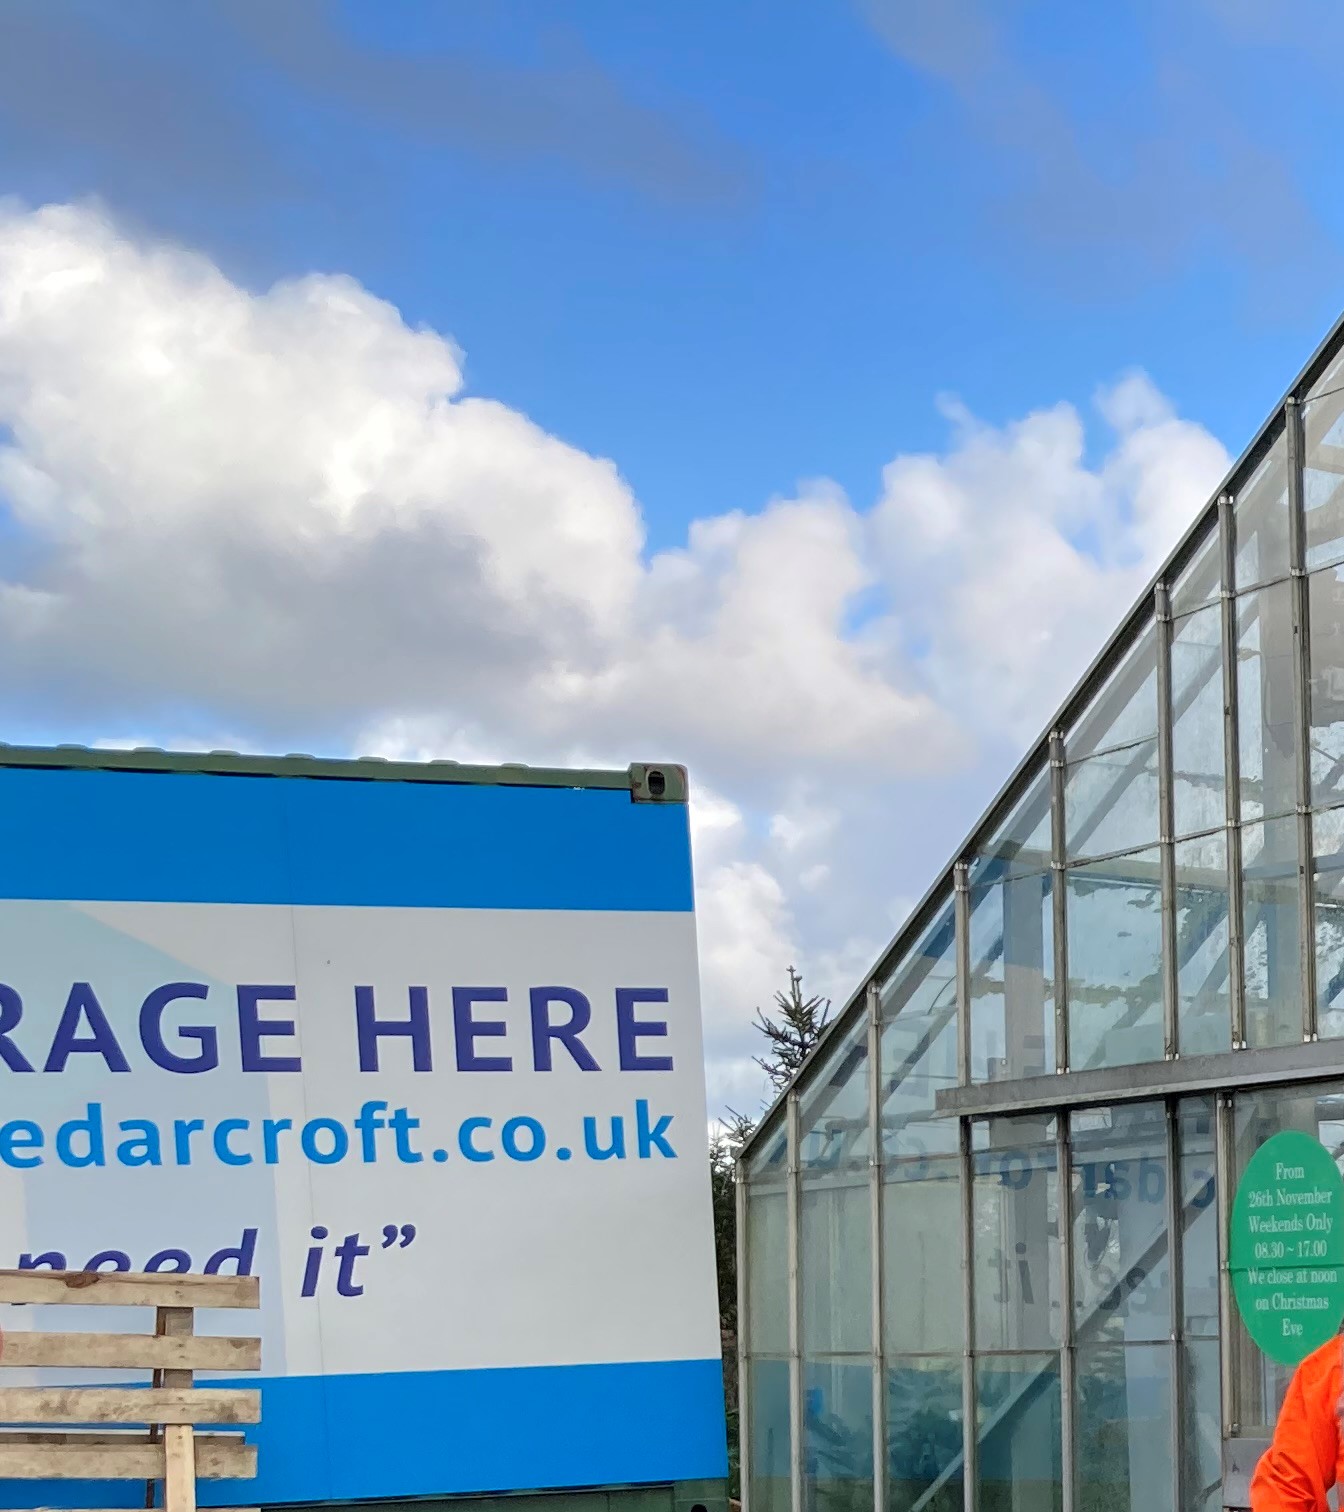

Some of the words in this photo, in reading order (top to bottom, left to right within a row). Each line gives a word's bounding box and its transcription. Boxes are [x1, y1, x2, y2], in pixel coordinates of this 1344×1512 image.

[354, 984, 674, 1073] HERE
[0, 1100, 679, 1169] edarcroft.co.uk
[1275, 1162, 1305, 1180] From
[1248, 1190, 1274, 1208] 26th
[1276, 1187, 1333, 1206] November
[1249, 1214, 1304, 1233] Weekends
[1306, 1213, 1333, 1234] Only
[1254, 1242, 1285, 1259] 08.30
[1297, 1240, 1328, 1257] 17.00
[1247, 1268, 1265, 1285] We
[1267, 1268, 1294, 1284] close
[1296, 1270, 1309, 1283] at
[1311, 1269, 1338, 1283] noon
[1256, 1297, 1270, 1310] on
[1272, 1292, 1329, 1310] Christmas
[1282, 1318, 1303, 1337] Eve
